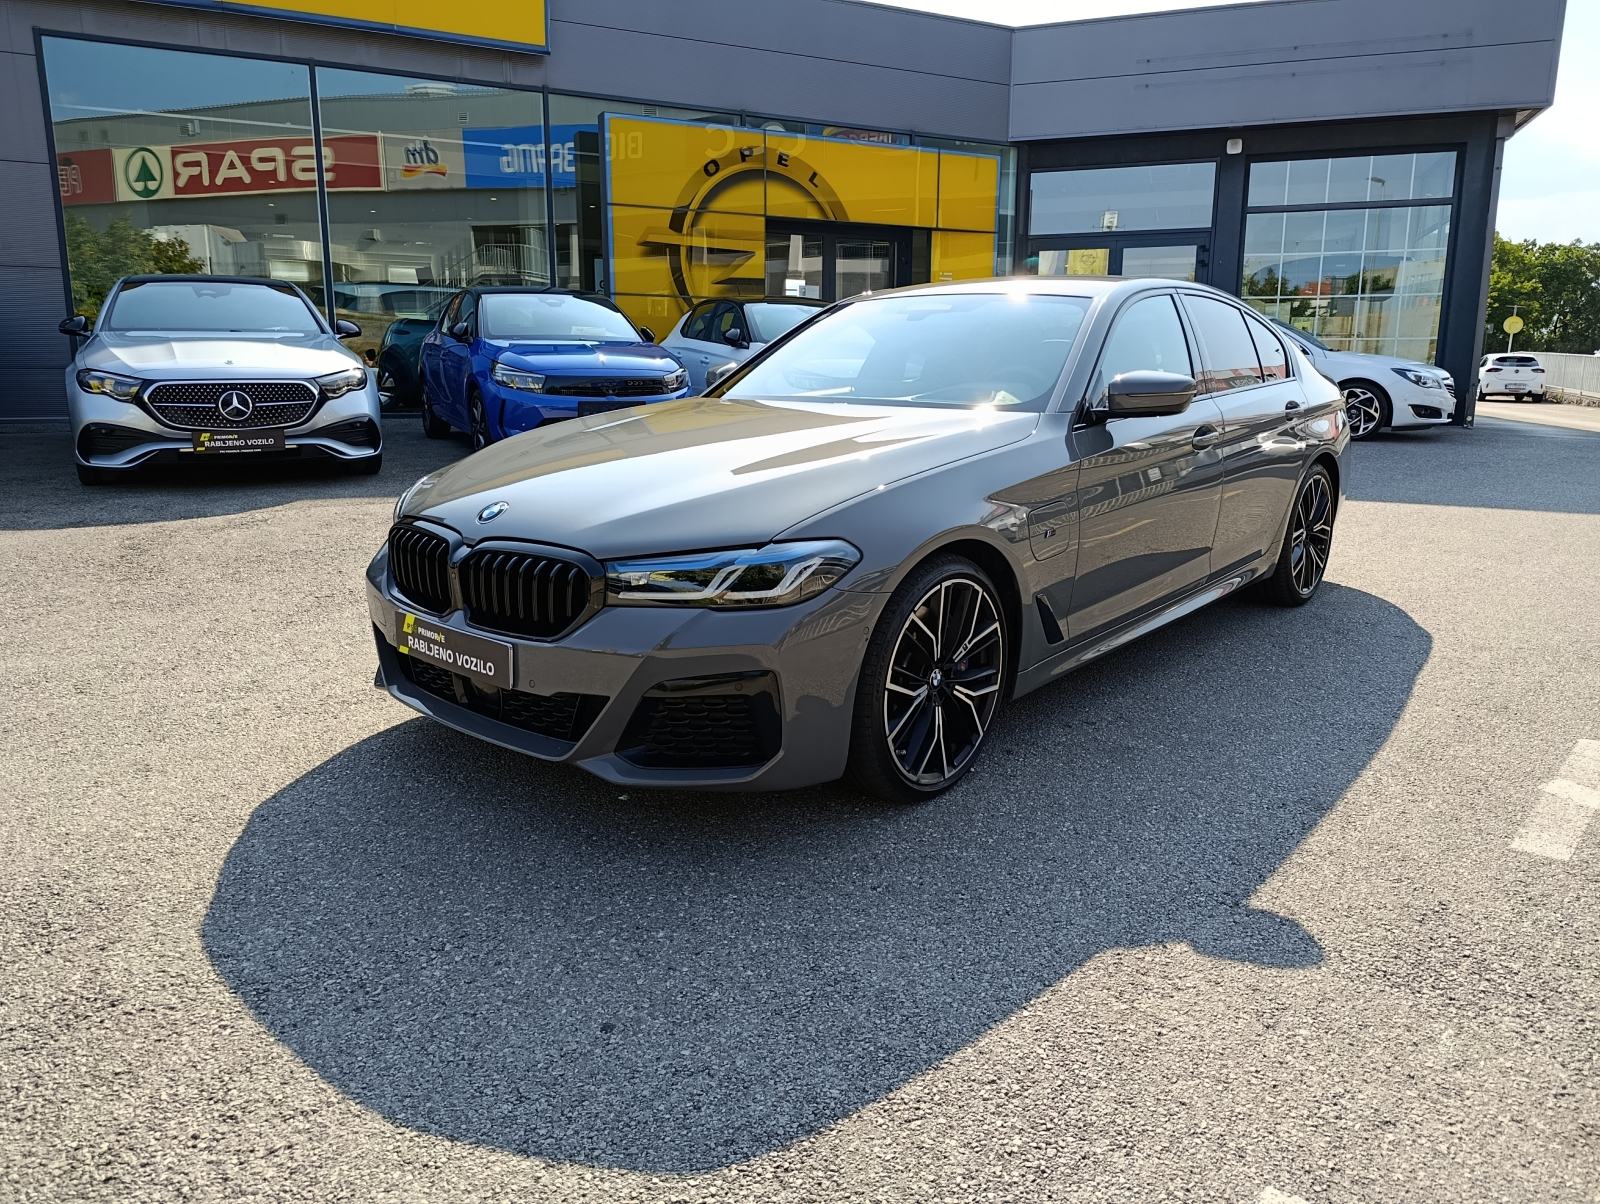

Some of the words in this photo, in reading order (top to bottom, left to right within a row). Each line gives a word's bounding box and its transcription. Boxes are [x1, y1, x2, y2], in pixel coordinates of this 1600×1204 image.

[703, 148, 820, 188] OPEL
[204, 439, 246, 447] RABLJENO
[246, 438, 275, 446] VOZILO
[407, 635, 454, 663] RABLJENO
[455, 652, 495, 676] VOZILO
